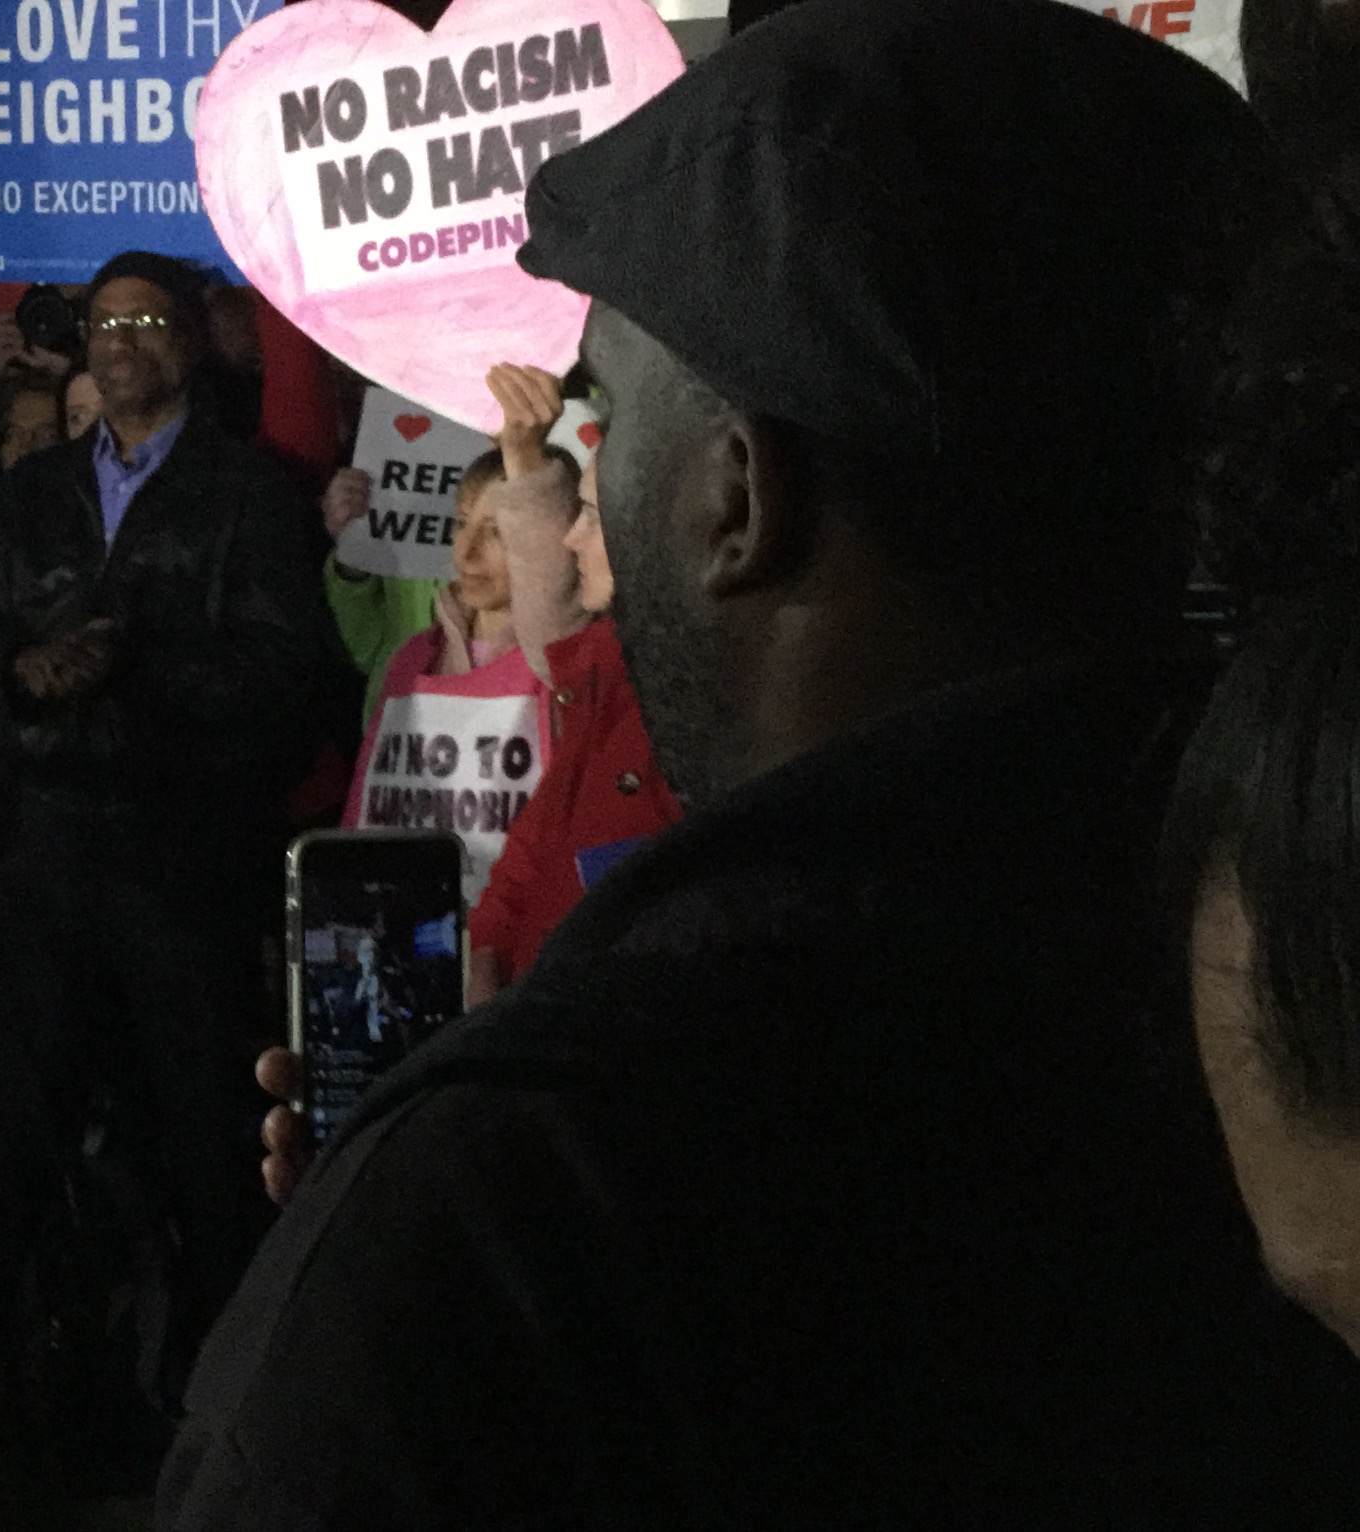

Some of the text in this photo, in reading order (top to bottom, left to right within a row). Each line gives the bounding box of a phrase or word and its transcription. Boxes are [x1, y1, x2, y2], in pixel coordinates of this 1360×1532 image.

[279, 22, 612, 154] NO RACISM
[34, 180, 207, 216] EXCEPTION
[316, 147, 414, 230] NO
[381, 458, 463, 496] REF
[475, 734, 532, 781] TO
